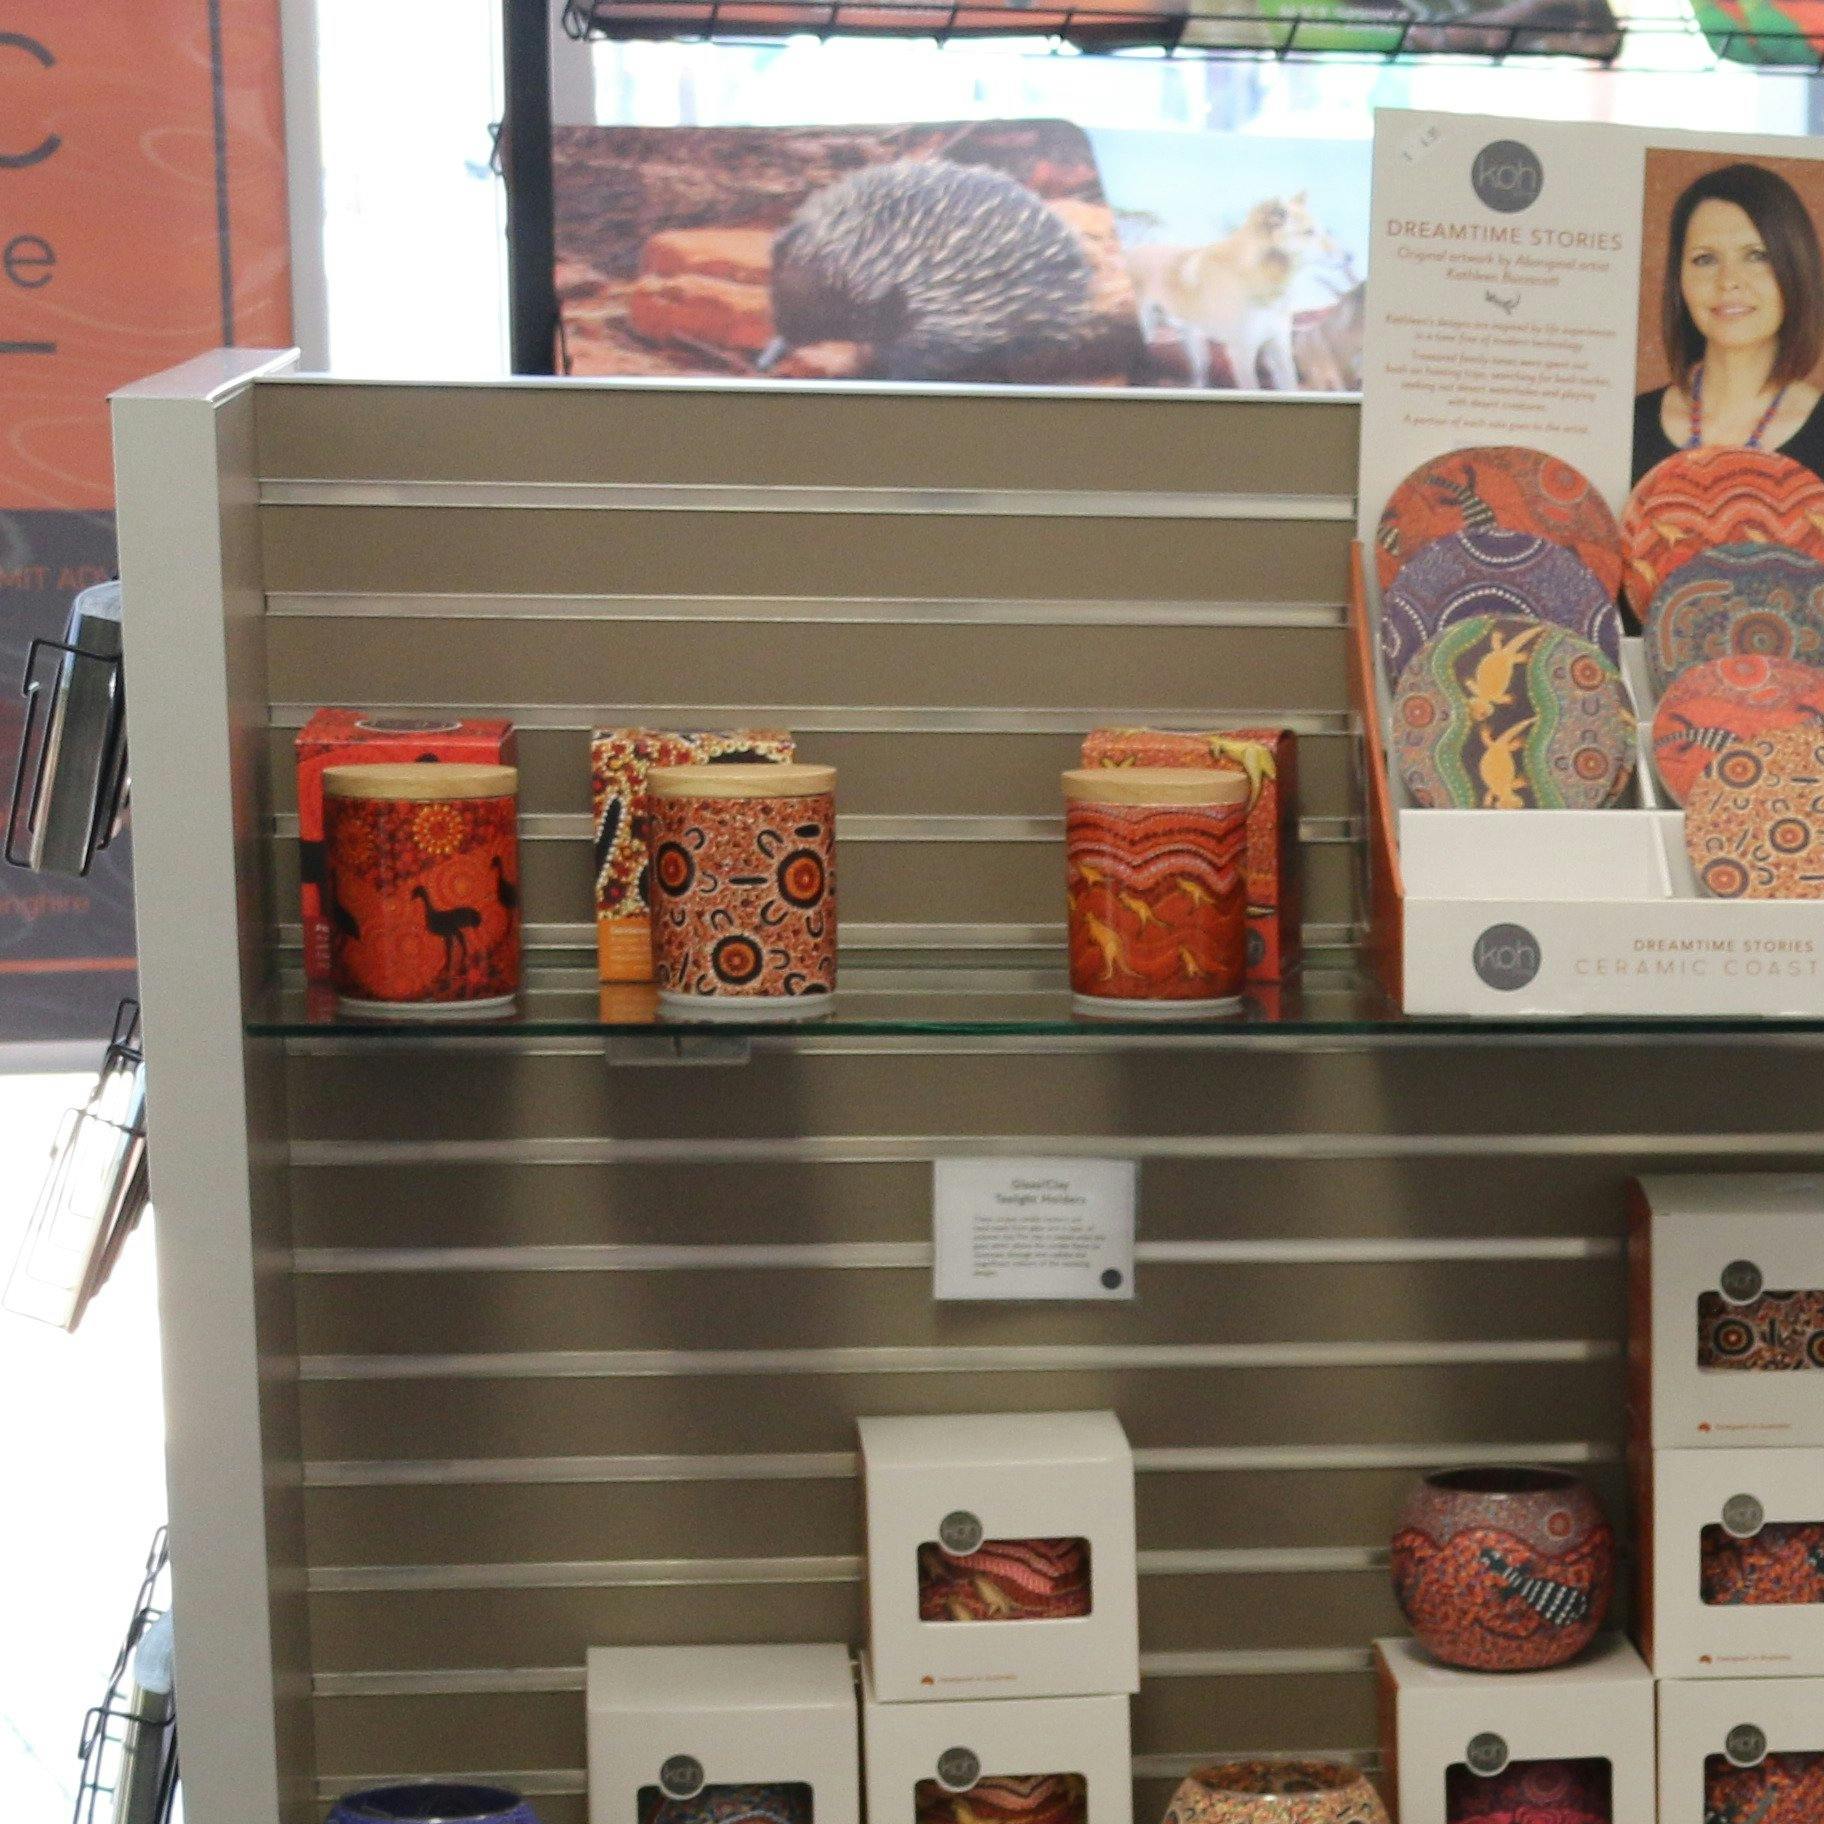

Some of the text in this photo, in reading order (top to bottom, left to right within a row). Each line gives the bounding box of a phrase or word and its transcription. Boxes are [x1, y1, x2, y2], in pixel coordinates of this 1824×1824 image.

[1478, 156, 1538, 190] koh
[1386, 219, 1624, 251] DREAMTIME STORIES
[1480, 938, 1537, 970] koh
[1633, 938, 1815, 953] DREAMTIME STORIES
[1575, 959, 1707, 976] CERAMIC
